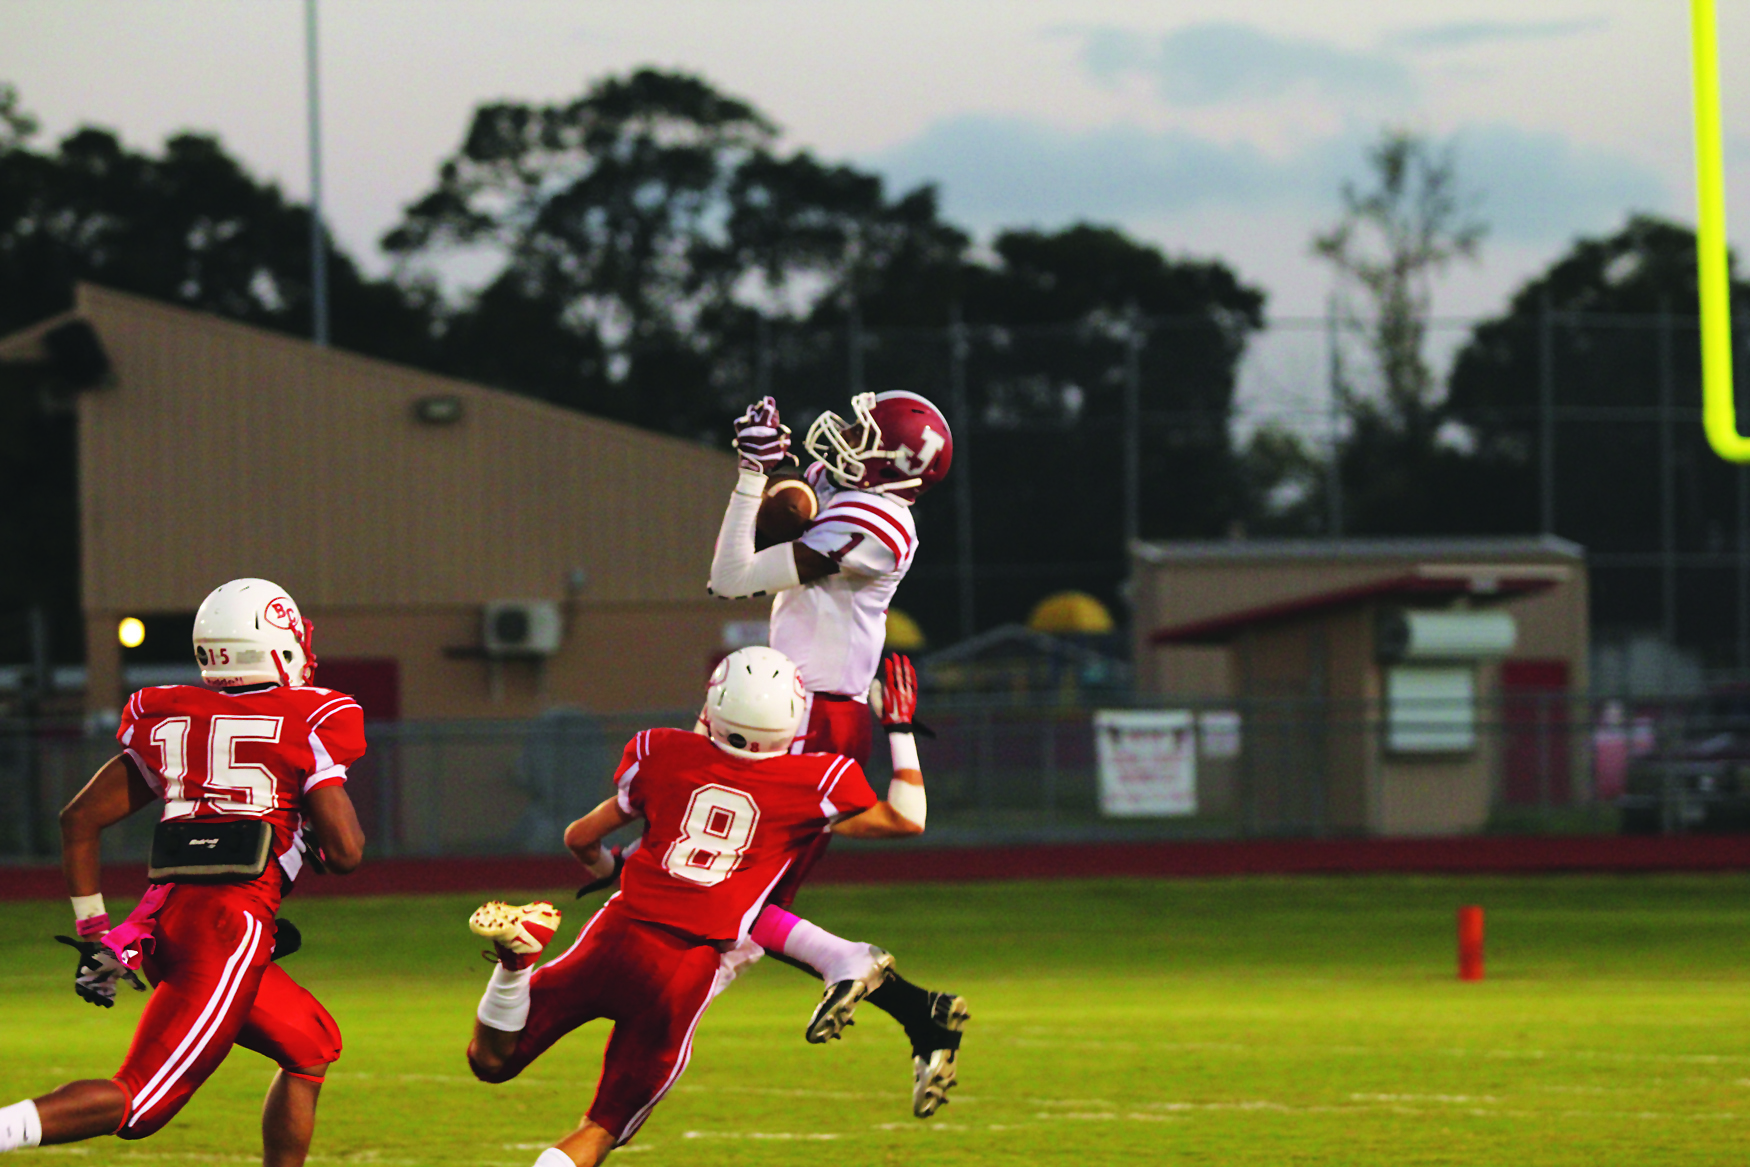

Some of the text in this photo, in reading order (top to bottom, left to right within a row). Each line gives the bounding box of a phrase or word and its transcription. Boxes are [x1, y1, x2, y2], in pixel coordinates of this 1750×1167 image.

[894, 425, 945, 476] J
[827, 532, 865, 562] 1
[209, 648, 230, 665] 15
[750, 742, 760, 753] 8
[150, 714, 284, 822] 15
[661, 783, 761, 887] 8
